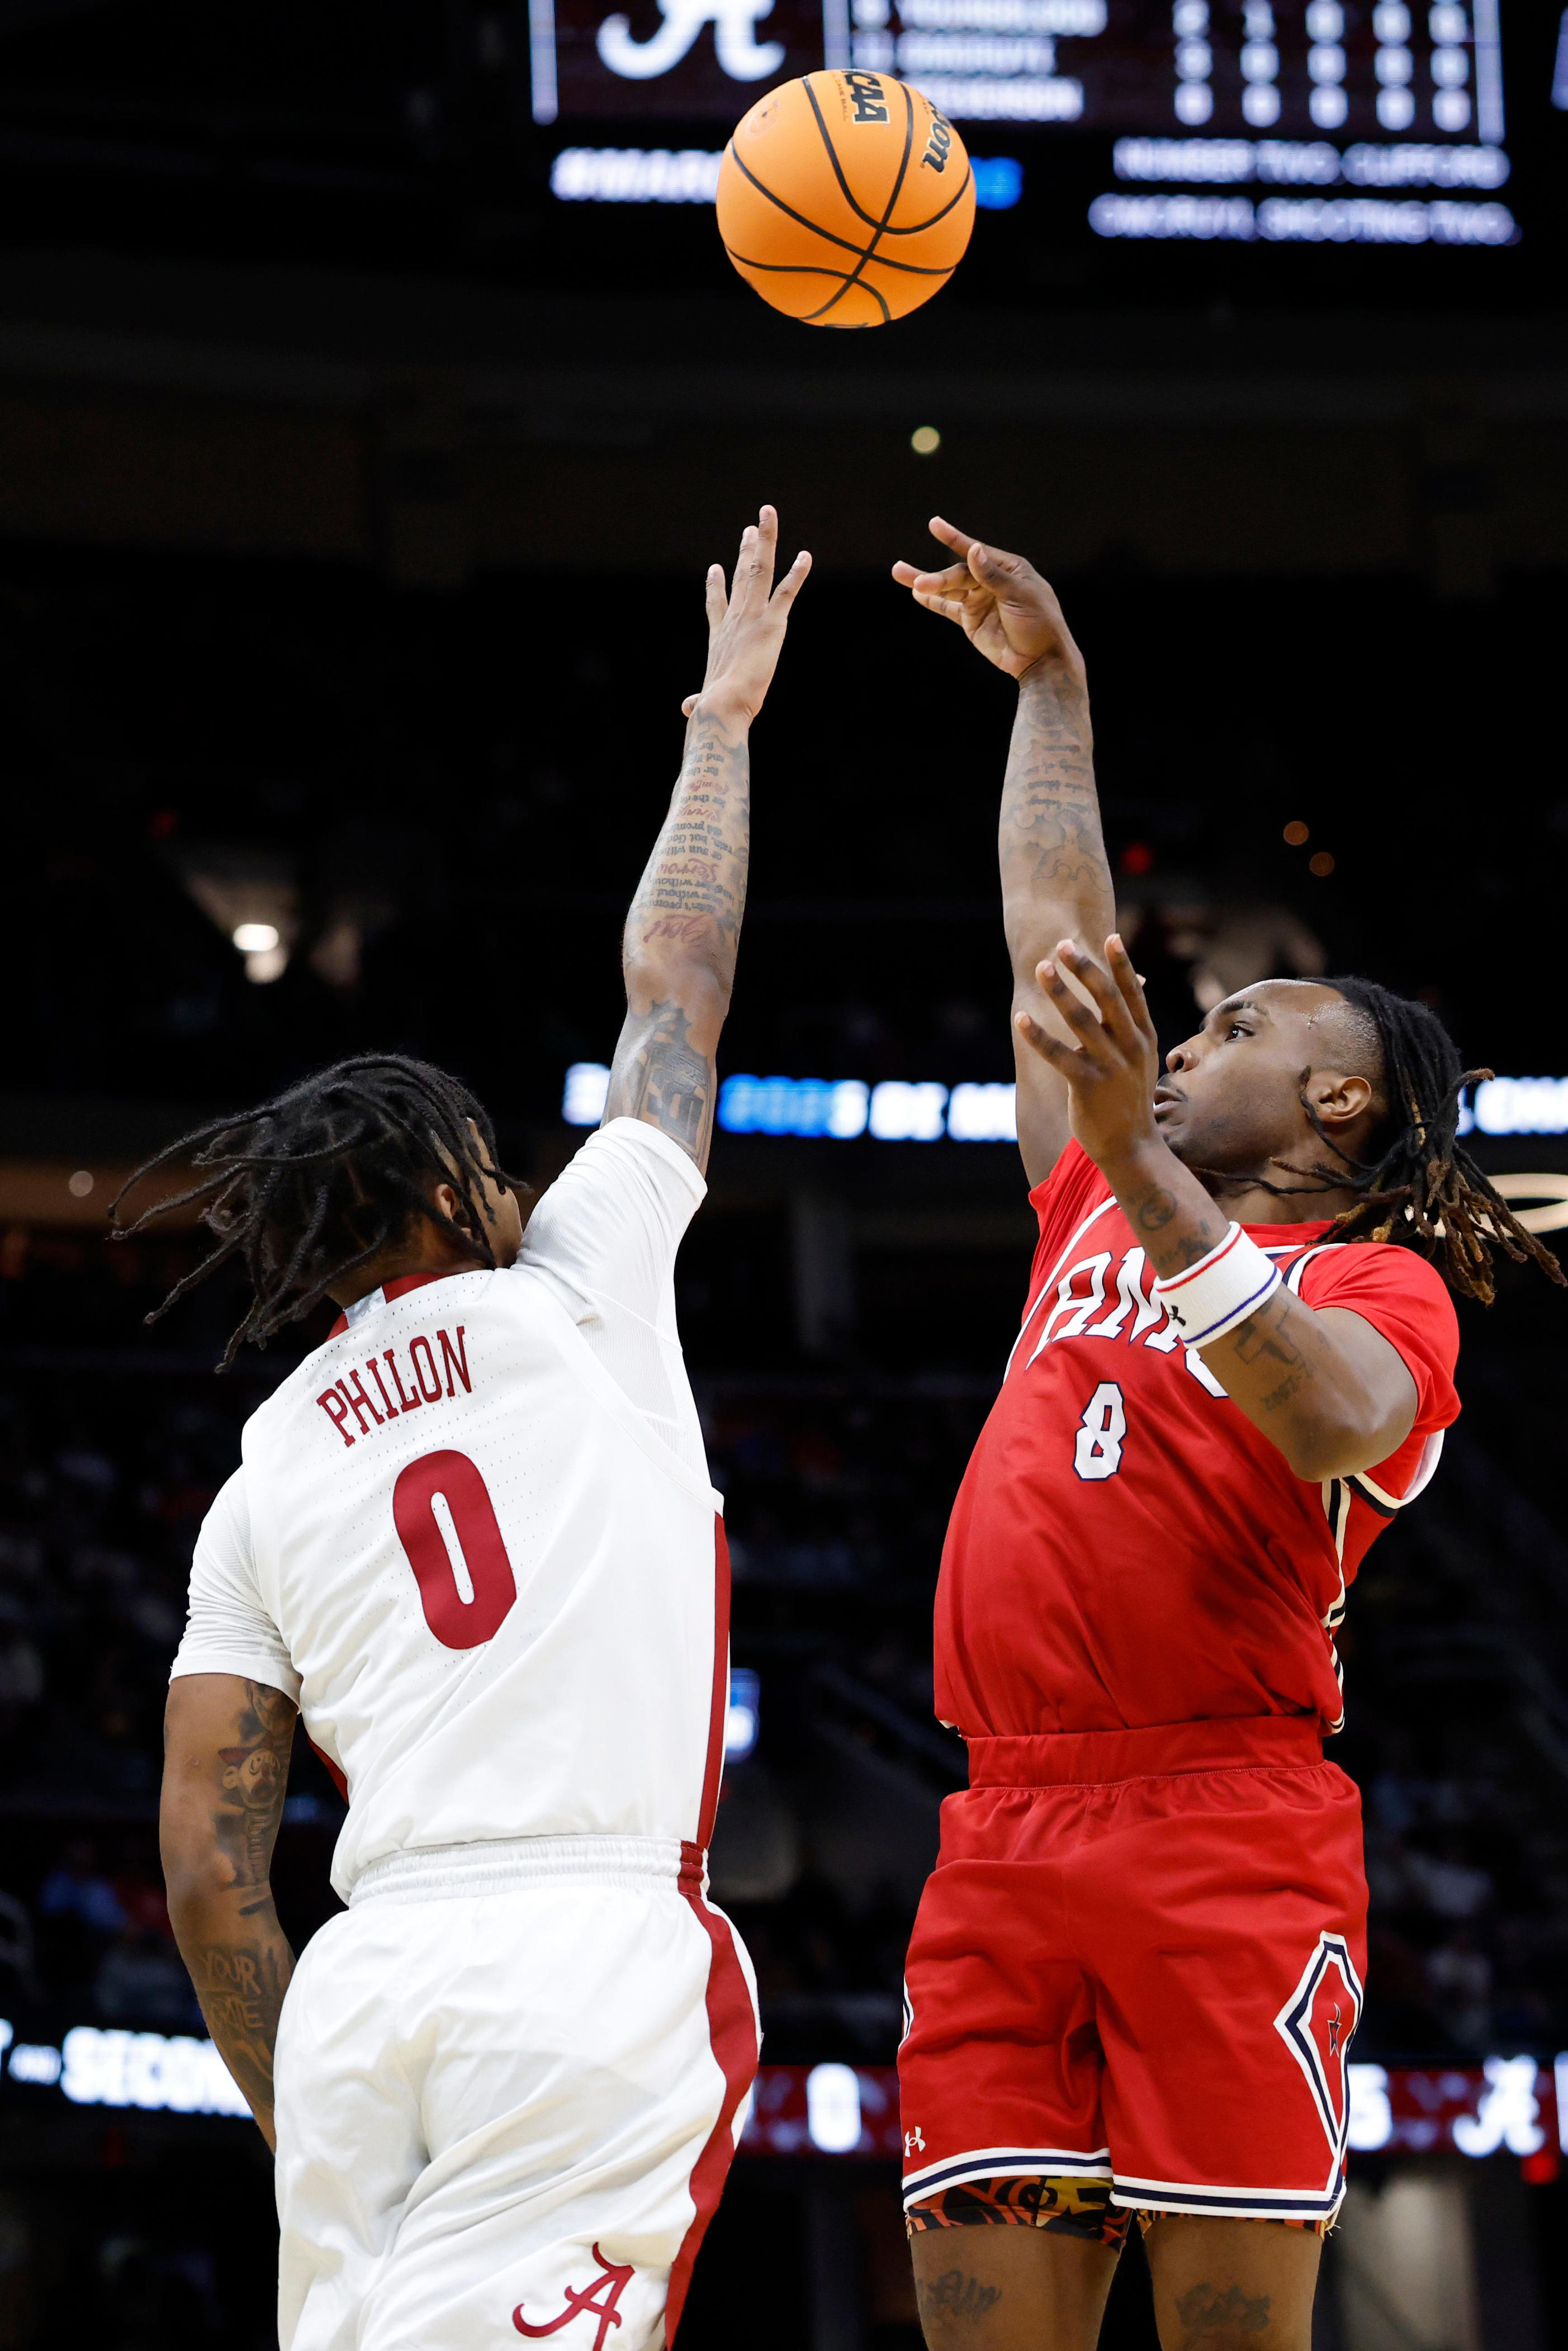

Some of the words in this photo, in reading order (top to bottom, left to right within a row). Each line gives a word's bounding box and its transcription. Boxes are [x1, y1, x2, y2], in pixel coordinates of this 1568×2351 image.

[922, 101, 951, 173] son
[316, 1325, 472, 1447] PHILON
[1073, 1381, 1127, 1481] 8
[392, 1449, 517, 1650] 0
